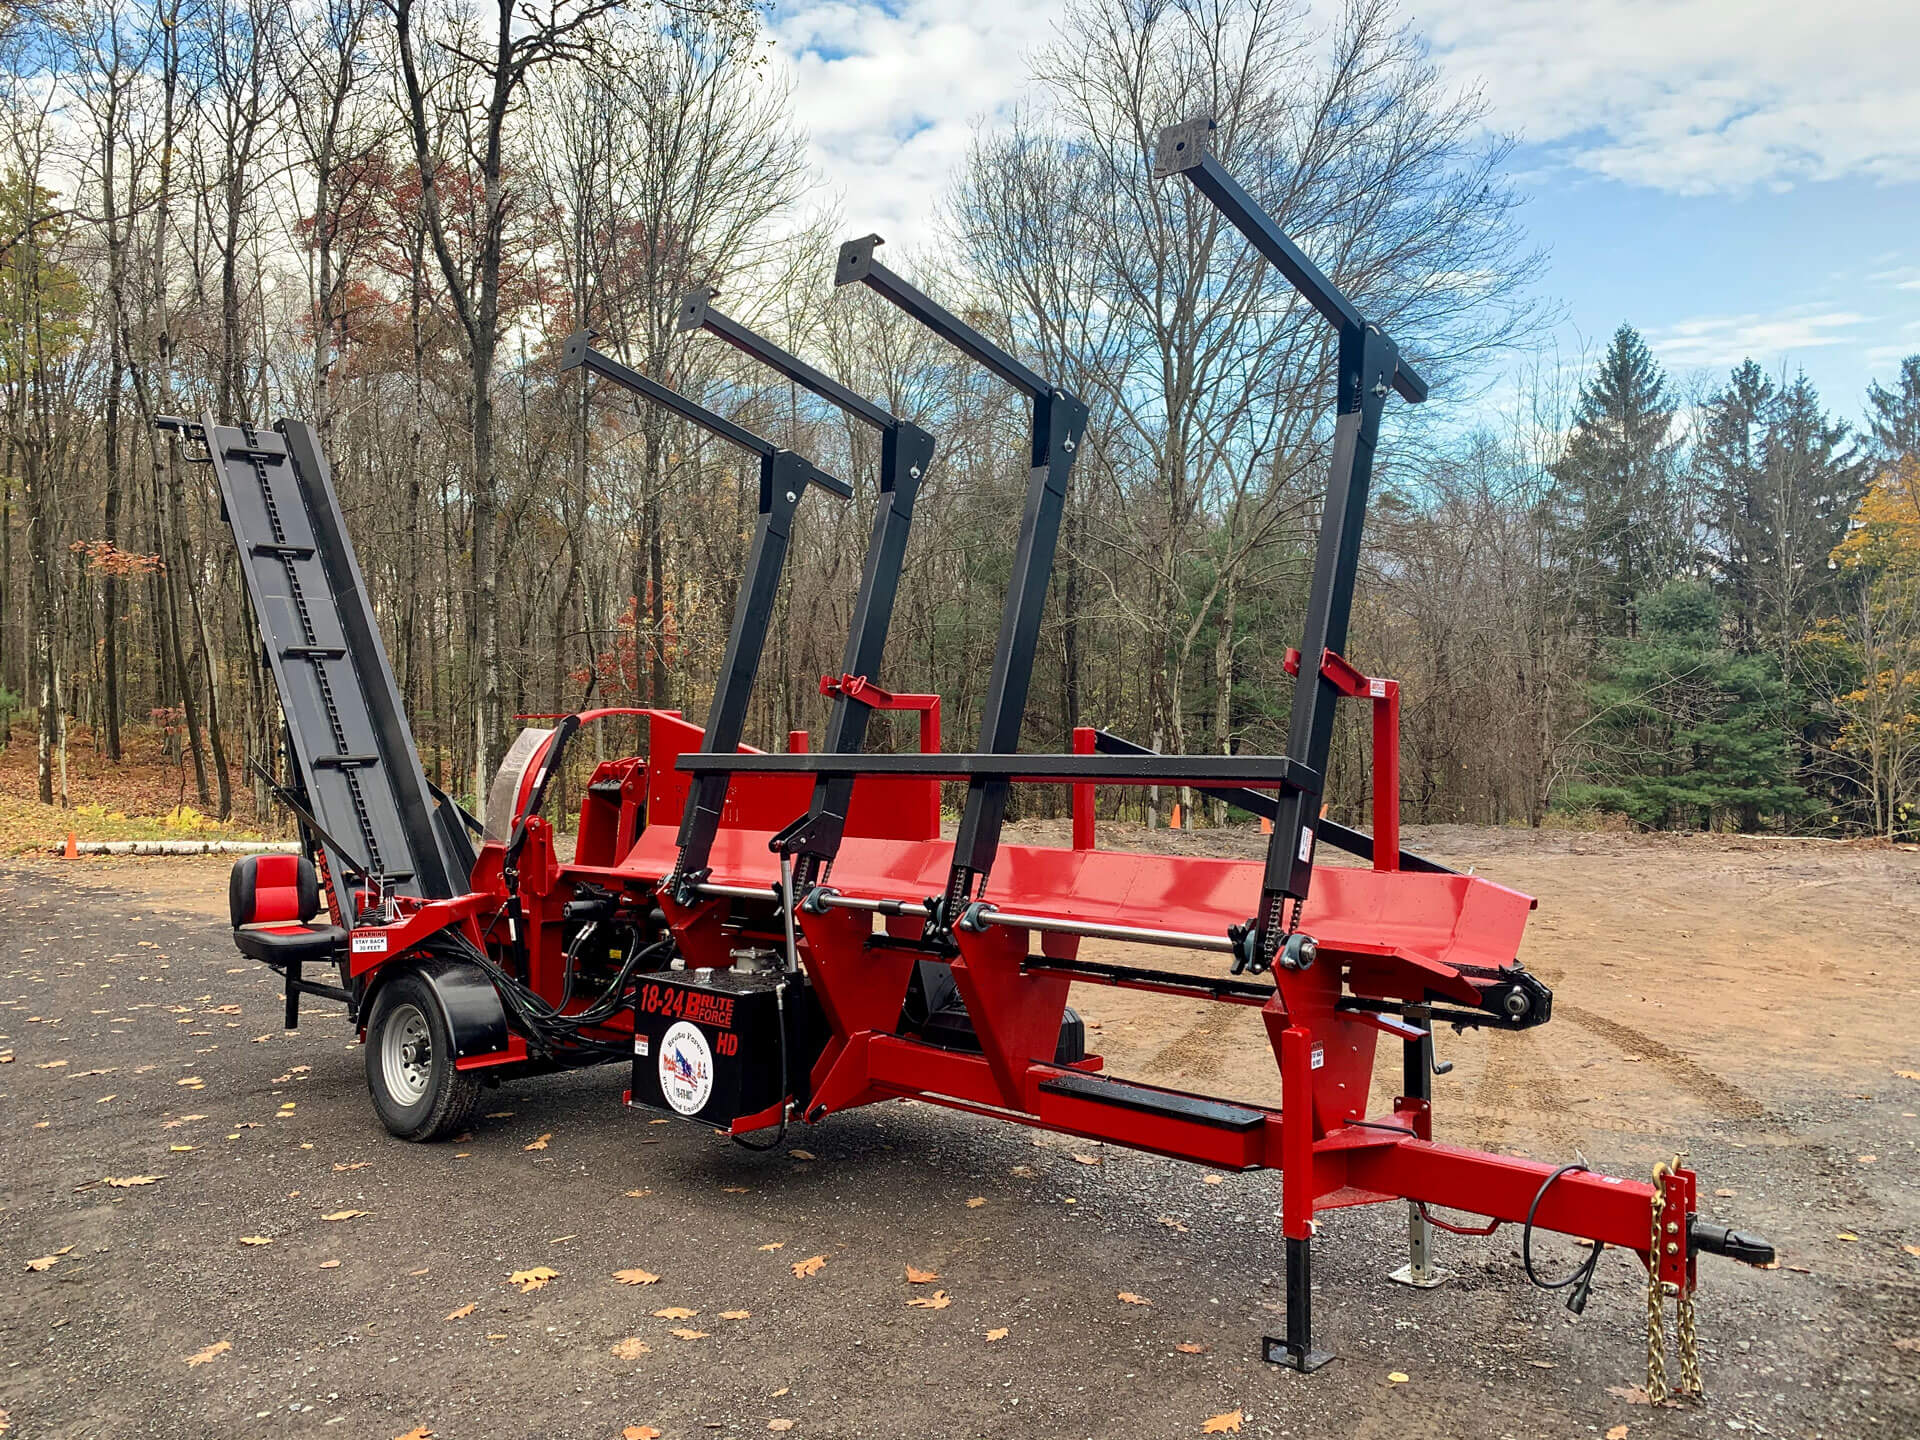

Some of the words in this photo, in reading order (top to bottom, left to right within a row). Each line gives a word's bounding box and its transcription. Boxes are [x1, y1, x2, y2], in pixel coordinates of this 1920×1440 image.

[641, 983, 685, 1018] 18-24
[685, 991, 735, 1016] BRUTE
[698, 1007, 732, 1025] FORCE
[716, 1031, 738, 1056] HD
